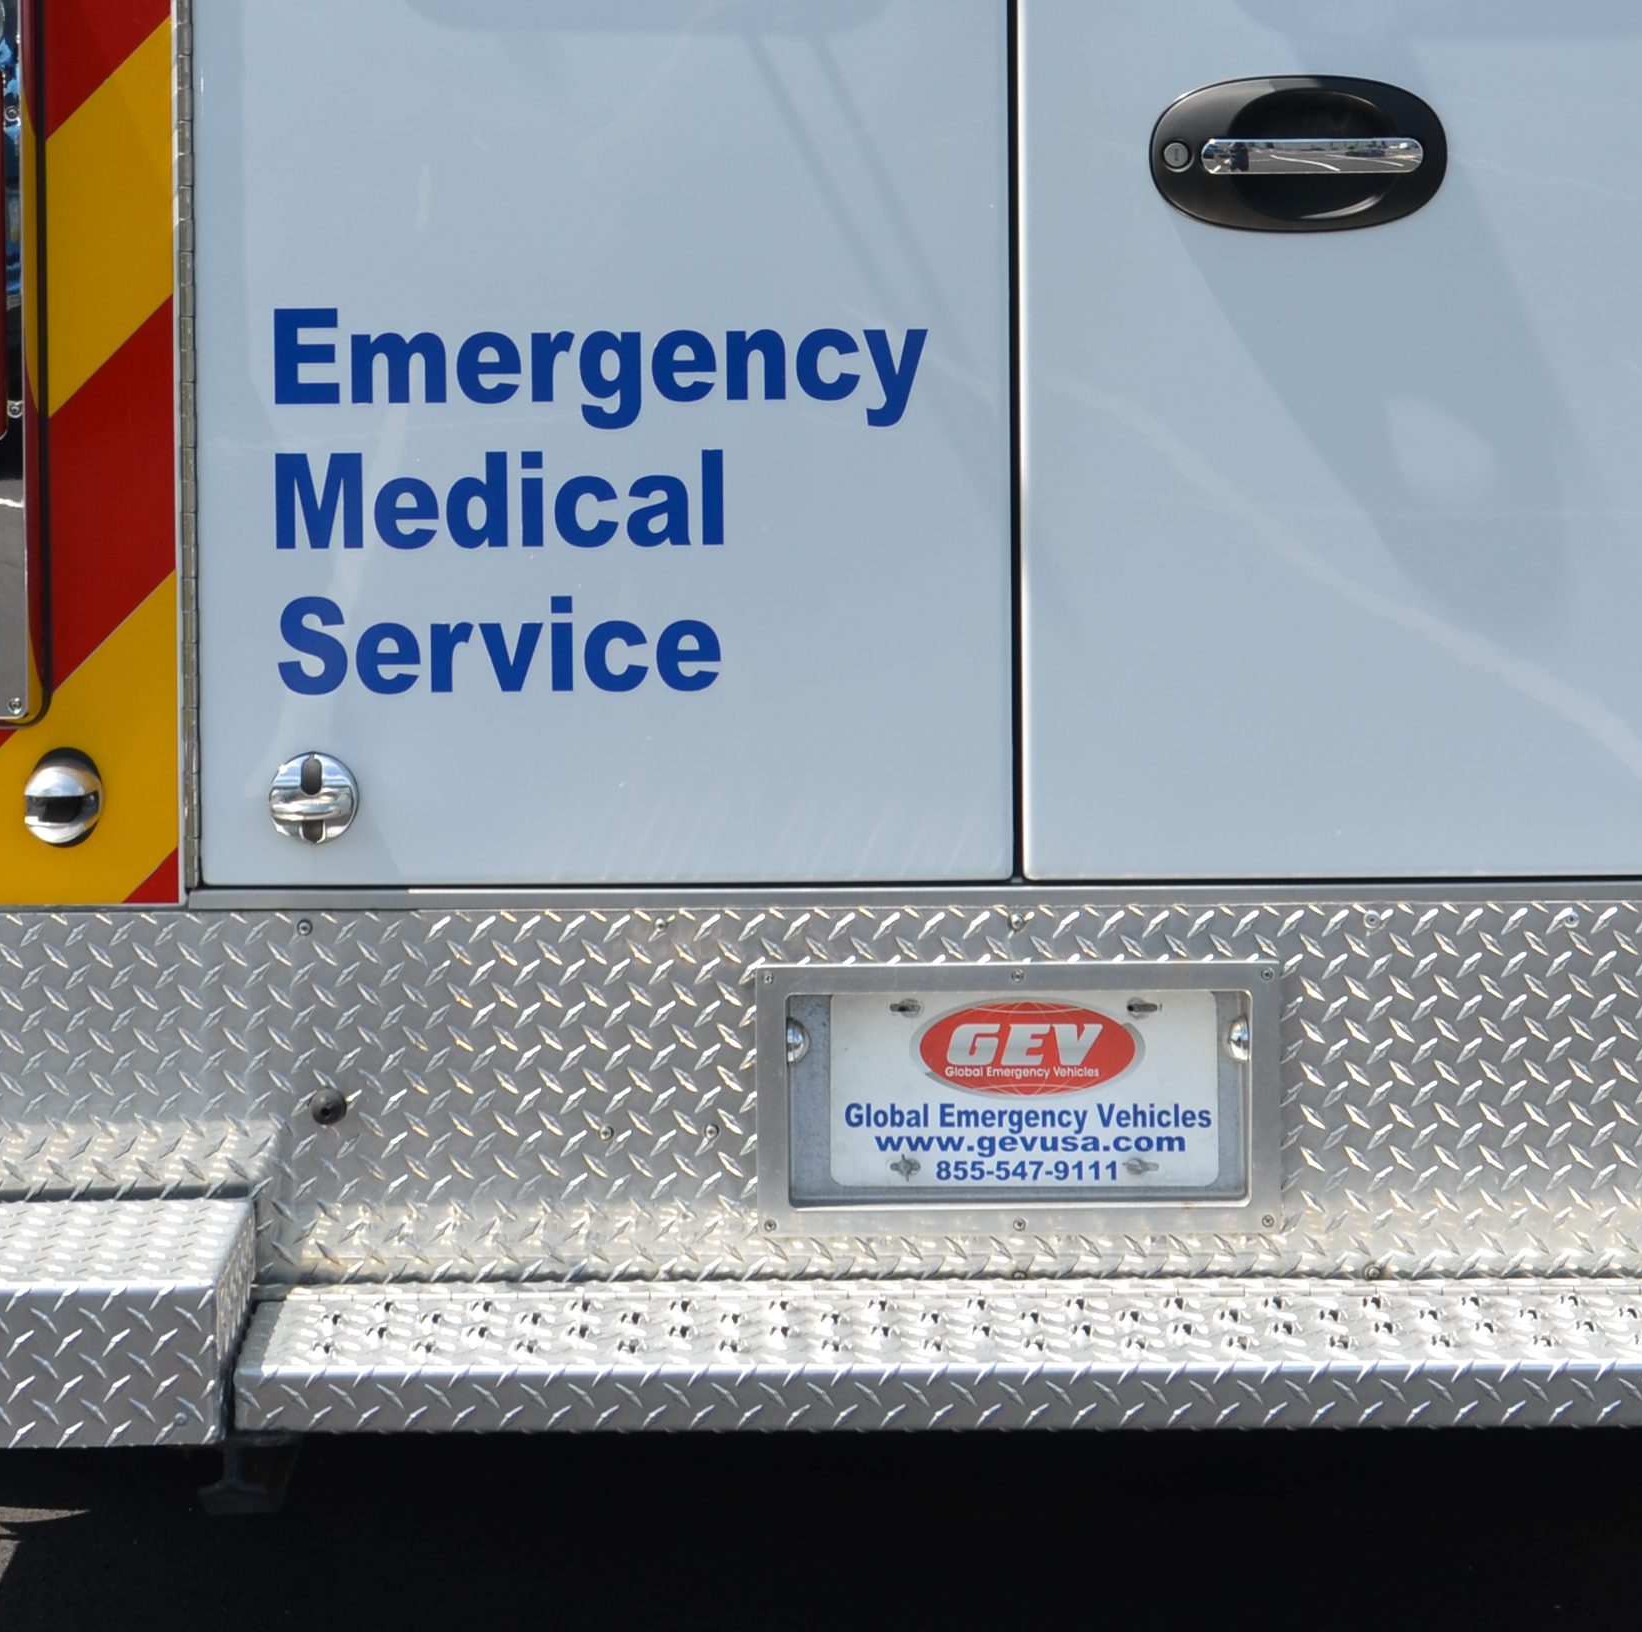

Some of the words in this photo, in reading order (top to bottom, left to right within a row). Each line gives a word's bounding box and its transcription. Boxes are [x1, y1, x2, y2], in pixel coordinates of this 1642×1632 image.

[273, 307, 929, 430] Emergency
[273, 448, 725, 551] Medical
[276, 595, 722, 696] Service
[946, 1023, 1103, 1066] GEV
[944, 1065, 984, 1079] Global
[986, 1066, 1051, 1080] Emergency
[1053, 1065, 1100, 1079] Vehicles
[844, 1103, 930, 1129] Global
[939, 1103, 1088, 1134] Emergency
[1096, 1102, 1212, 1129] Vehicles
[874, 1134, 1187, 1157] www.gevusa.com
[935, 1159, 1119, 1182] 855-547-9111
